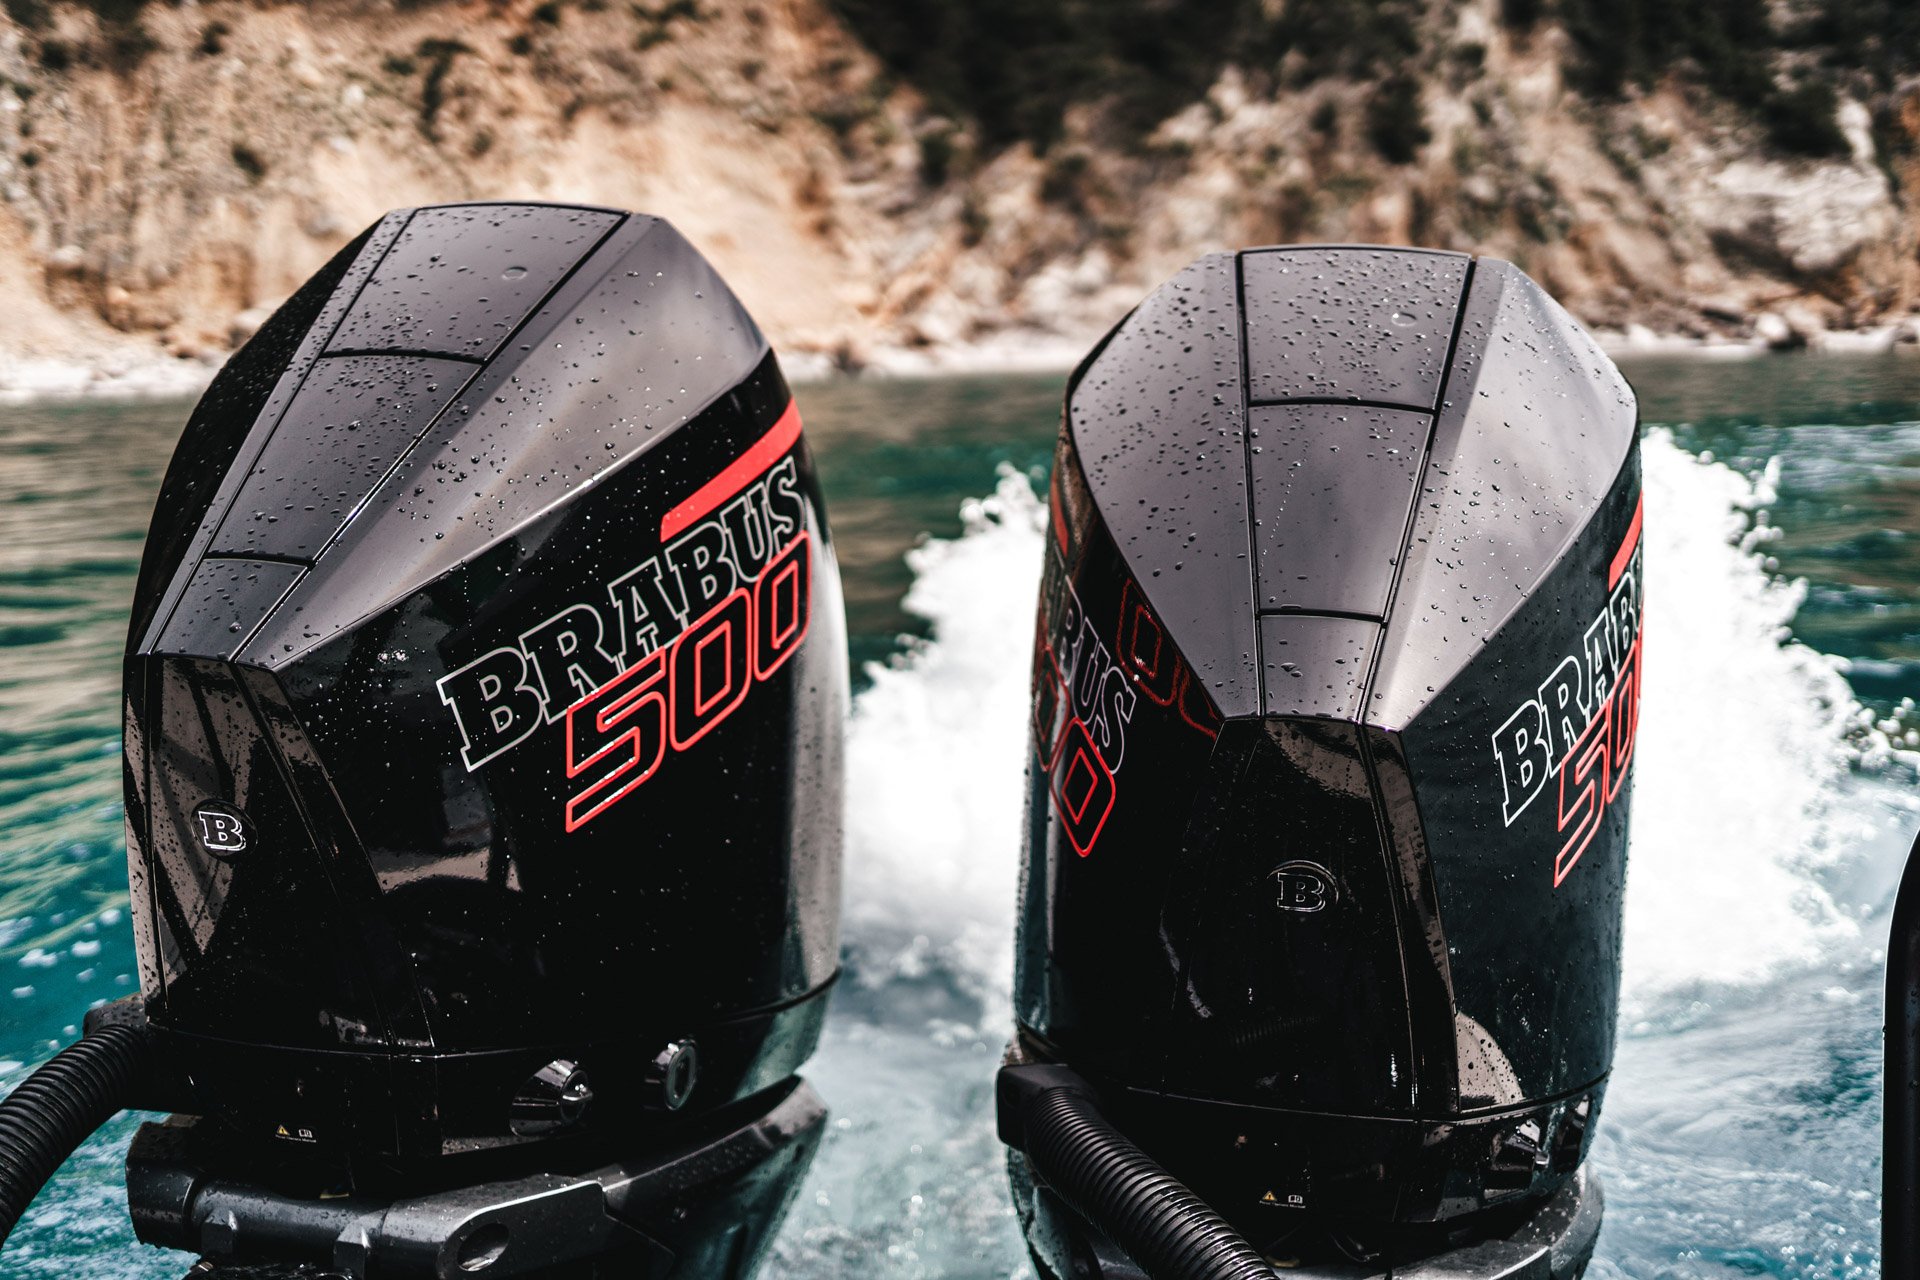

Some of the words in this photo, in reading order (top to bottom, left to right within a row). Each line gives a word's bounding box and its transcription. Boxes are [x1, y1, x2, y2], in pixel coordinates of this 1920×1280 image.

[436, 456, 807, 773] BRABUS
[565, 530, 812, 833] 500
[1553, 592, 1644, 889] 50
[198, 810, 247, 851] B
[1276, 872, 1326, 913] B
